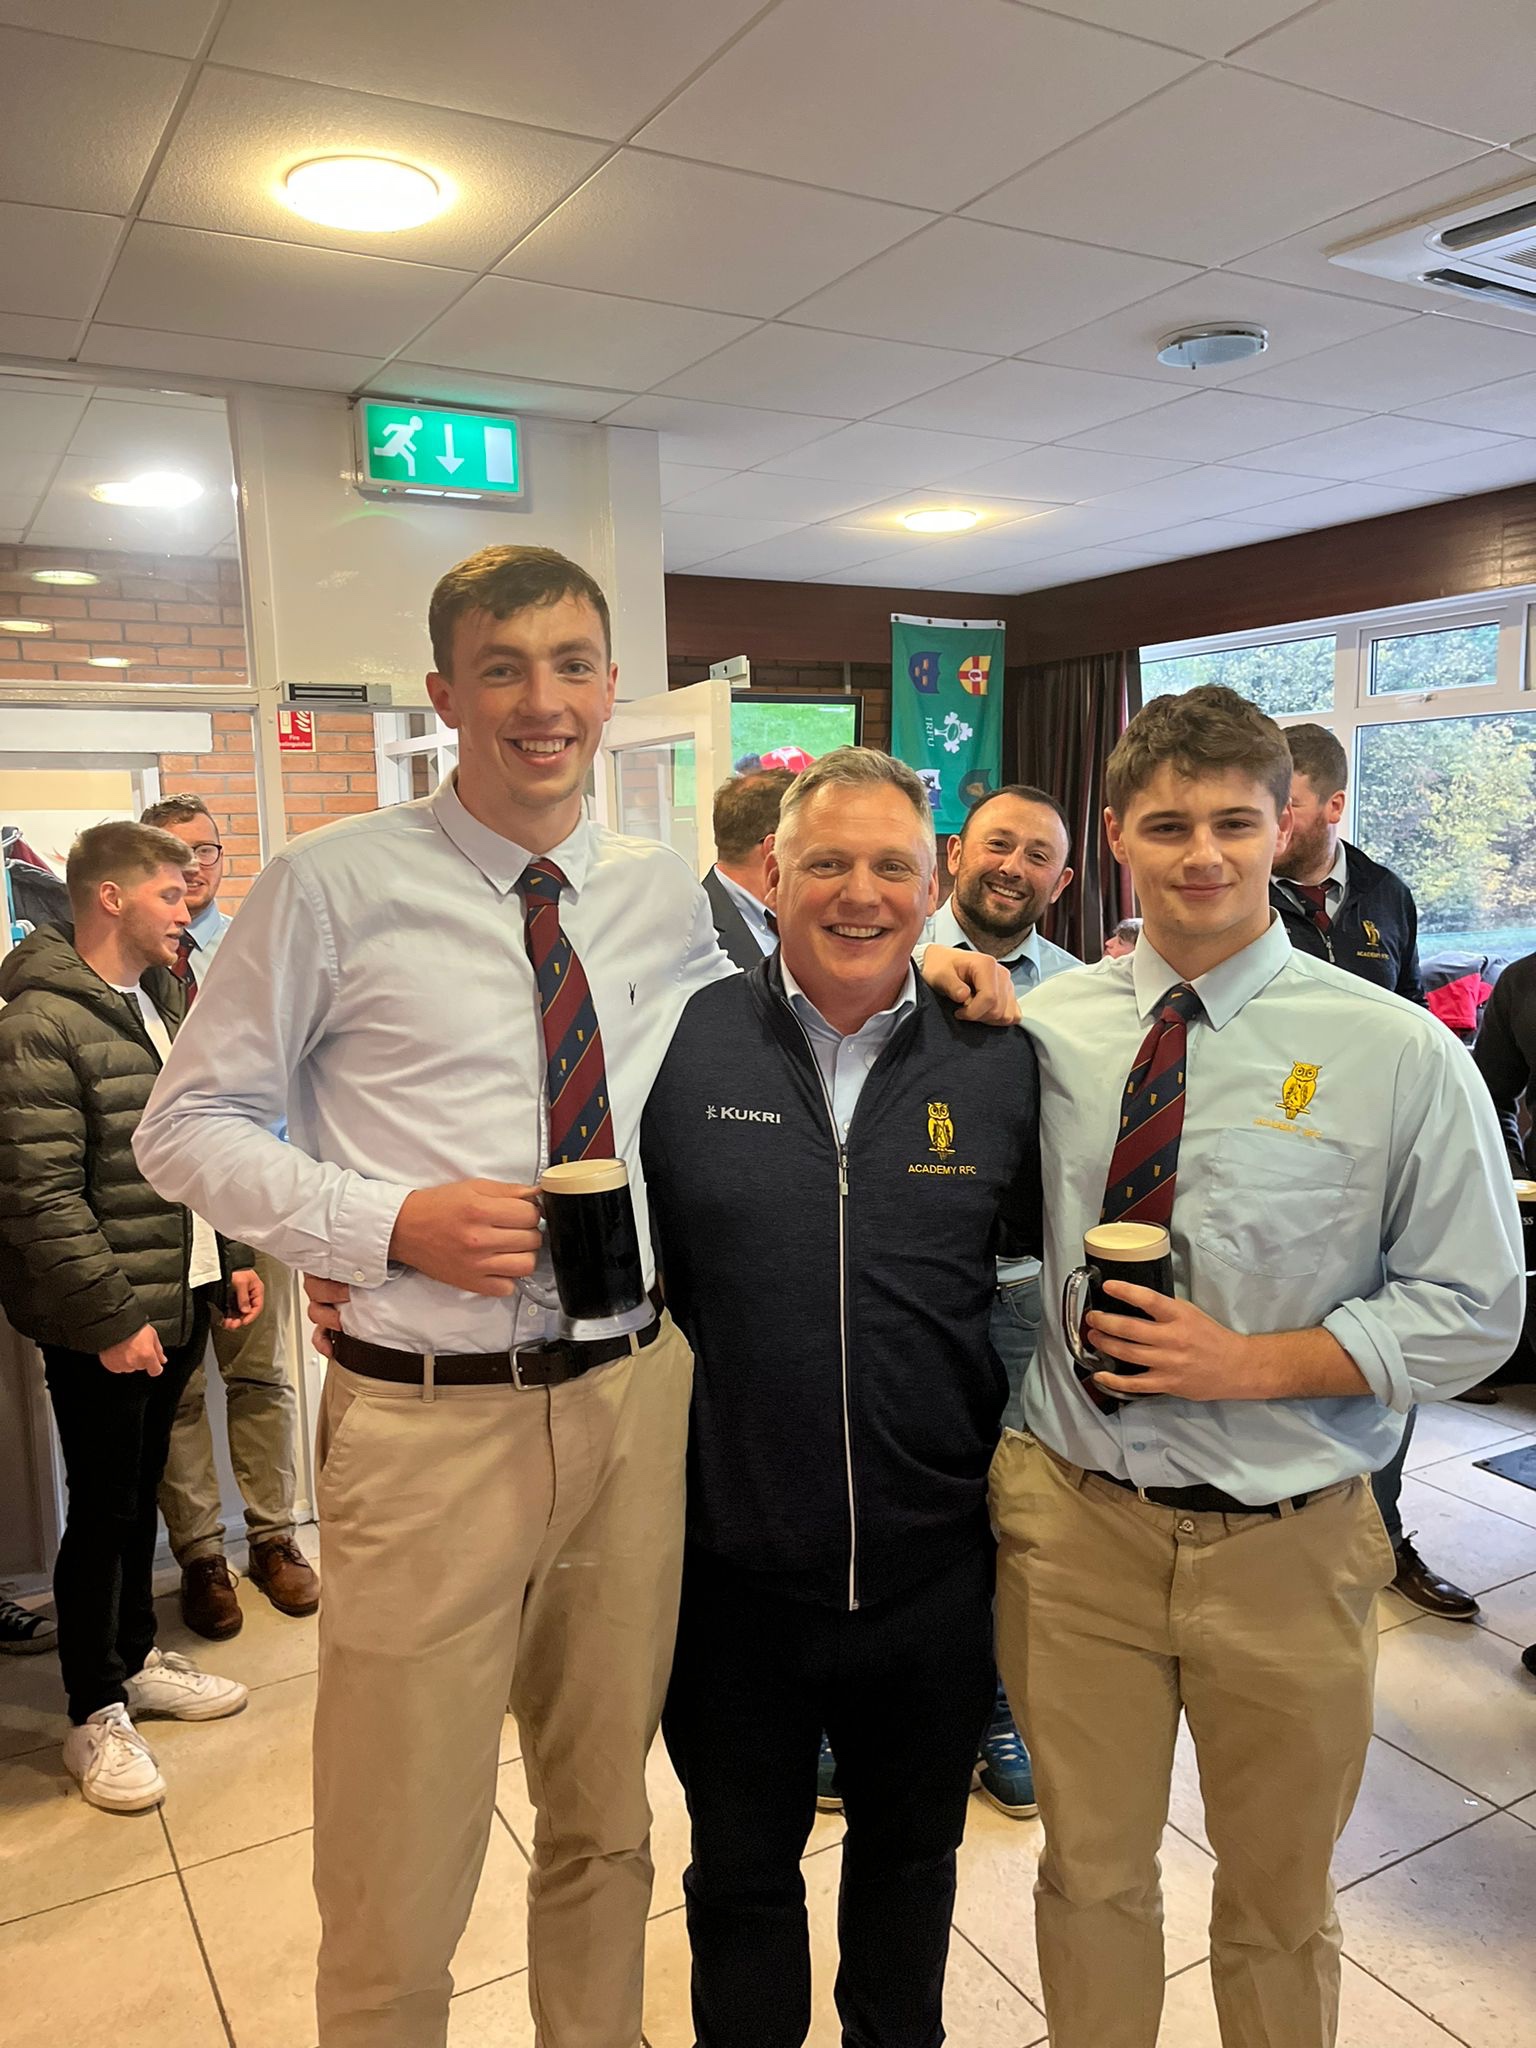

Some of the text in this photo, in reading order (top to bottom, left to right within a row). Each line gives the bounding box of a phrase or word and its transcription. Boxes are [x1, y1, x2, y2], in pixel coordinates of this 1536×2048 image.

[925, 717, 935, 747] IRFU
[720, 1106, 781, 1124] KUKRI
[908, 1164, 977, 1175] ACADEMY RFC
